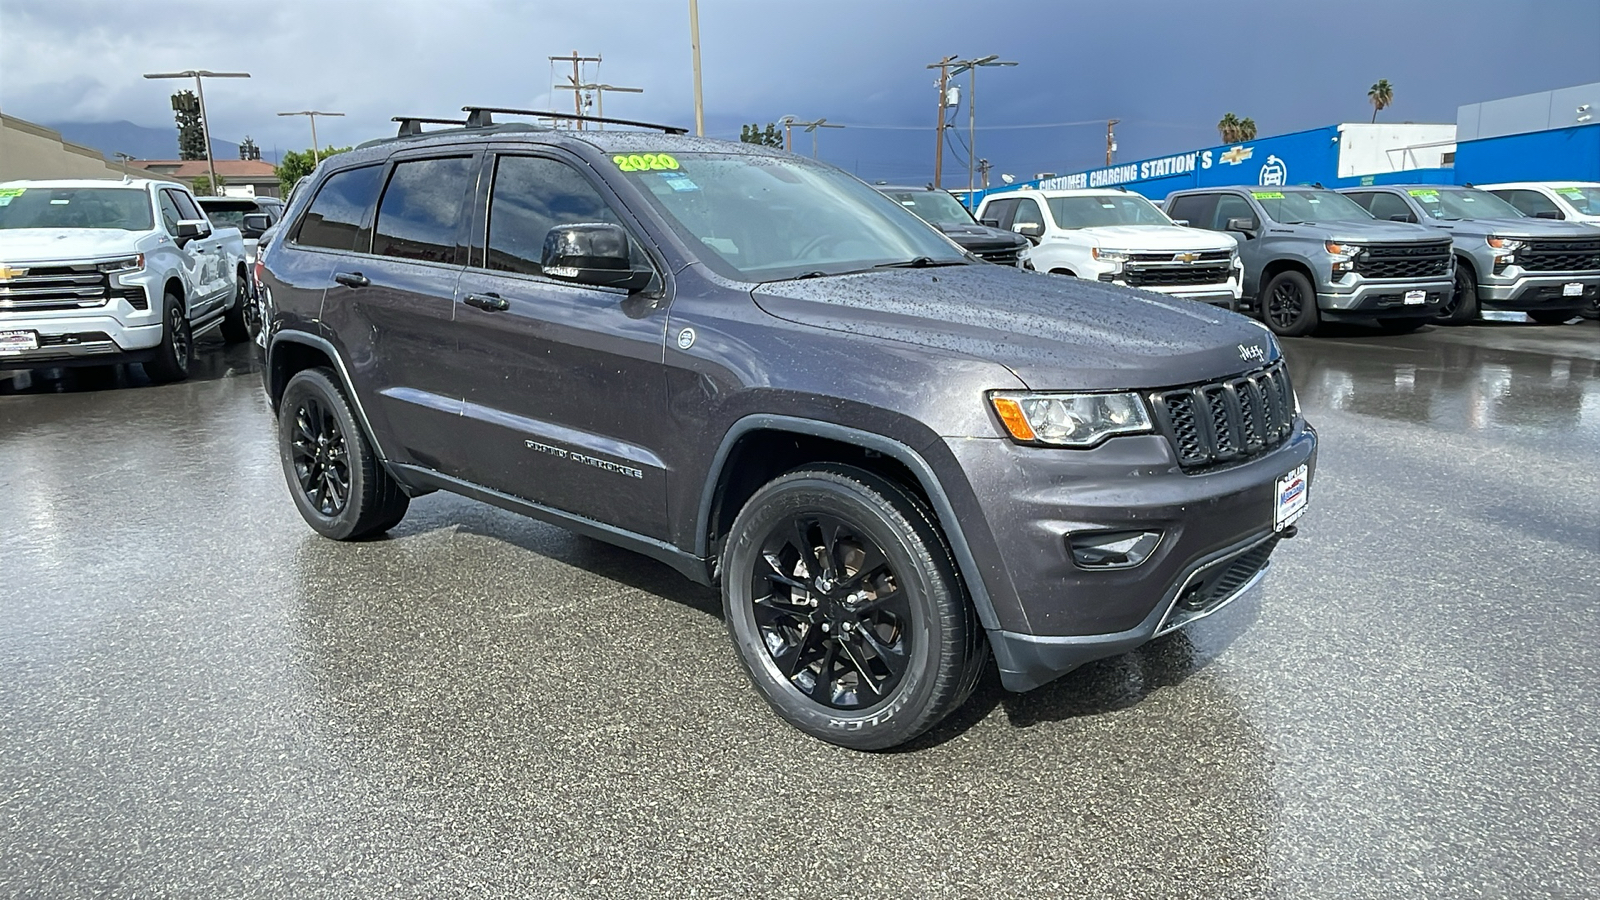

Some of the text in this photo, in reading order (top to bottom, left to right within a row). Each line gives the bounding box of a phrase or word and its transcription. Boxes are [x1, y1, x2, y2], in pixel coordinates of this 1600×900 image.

[613, 154, 680, 172] 2020
[1039, 151, 1212, 191] CUSTOMER CHARGING STATION'S
[525, 440, 643, 479] GRAND CHEROKEE
